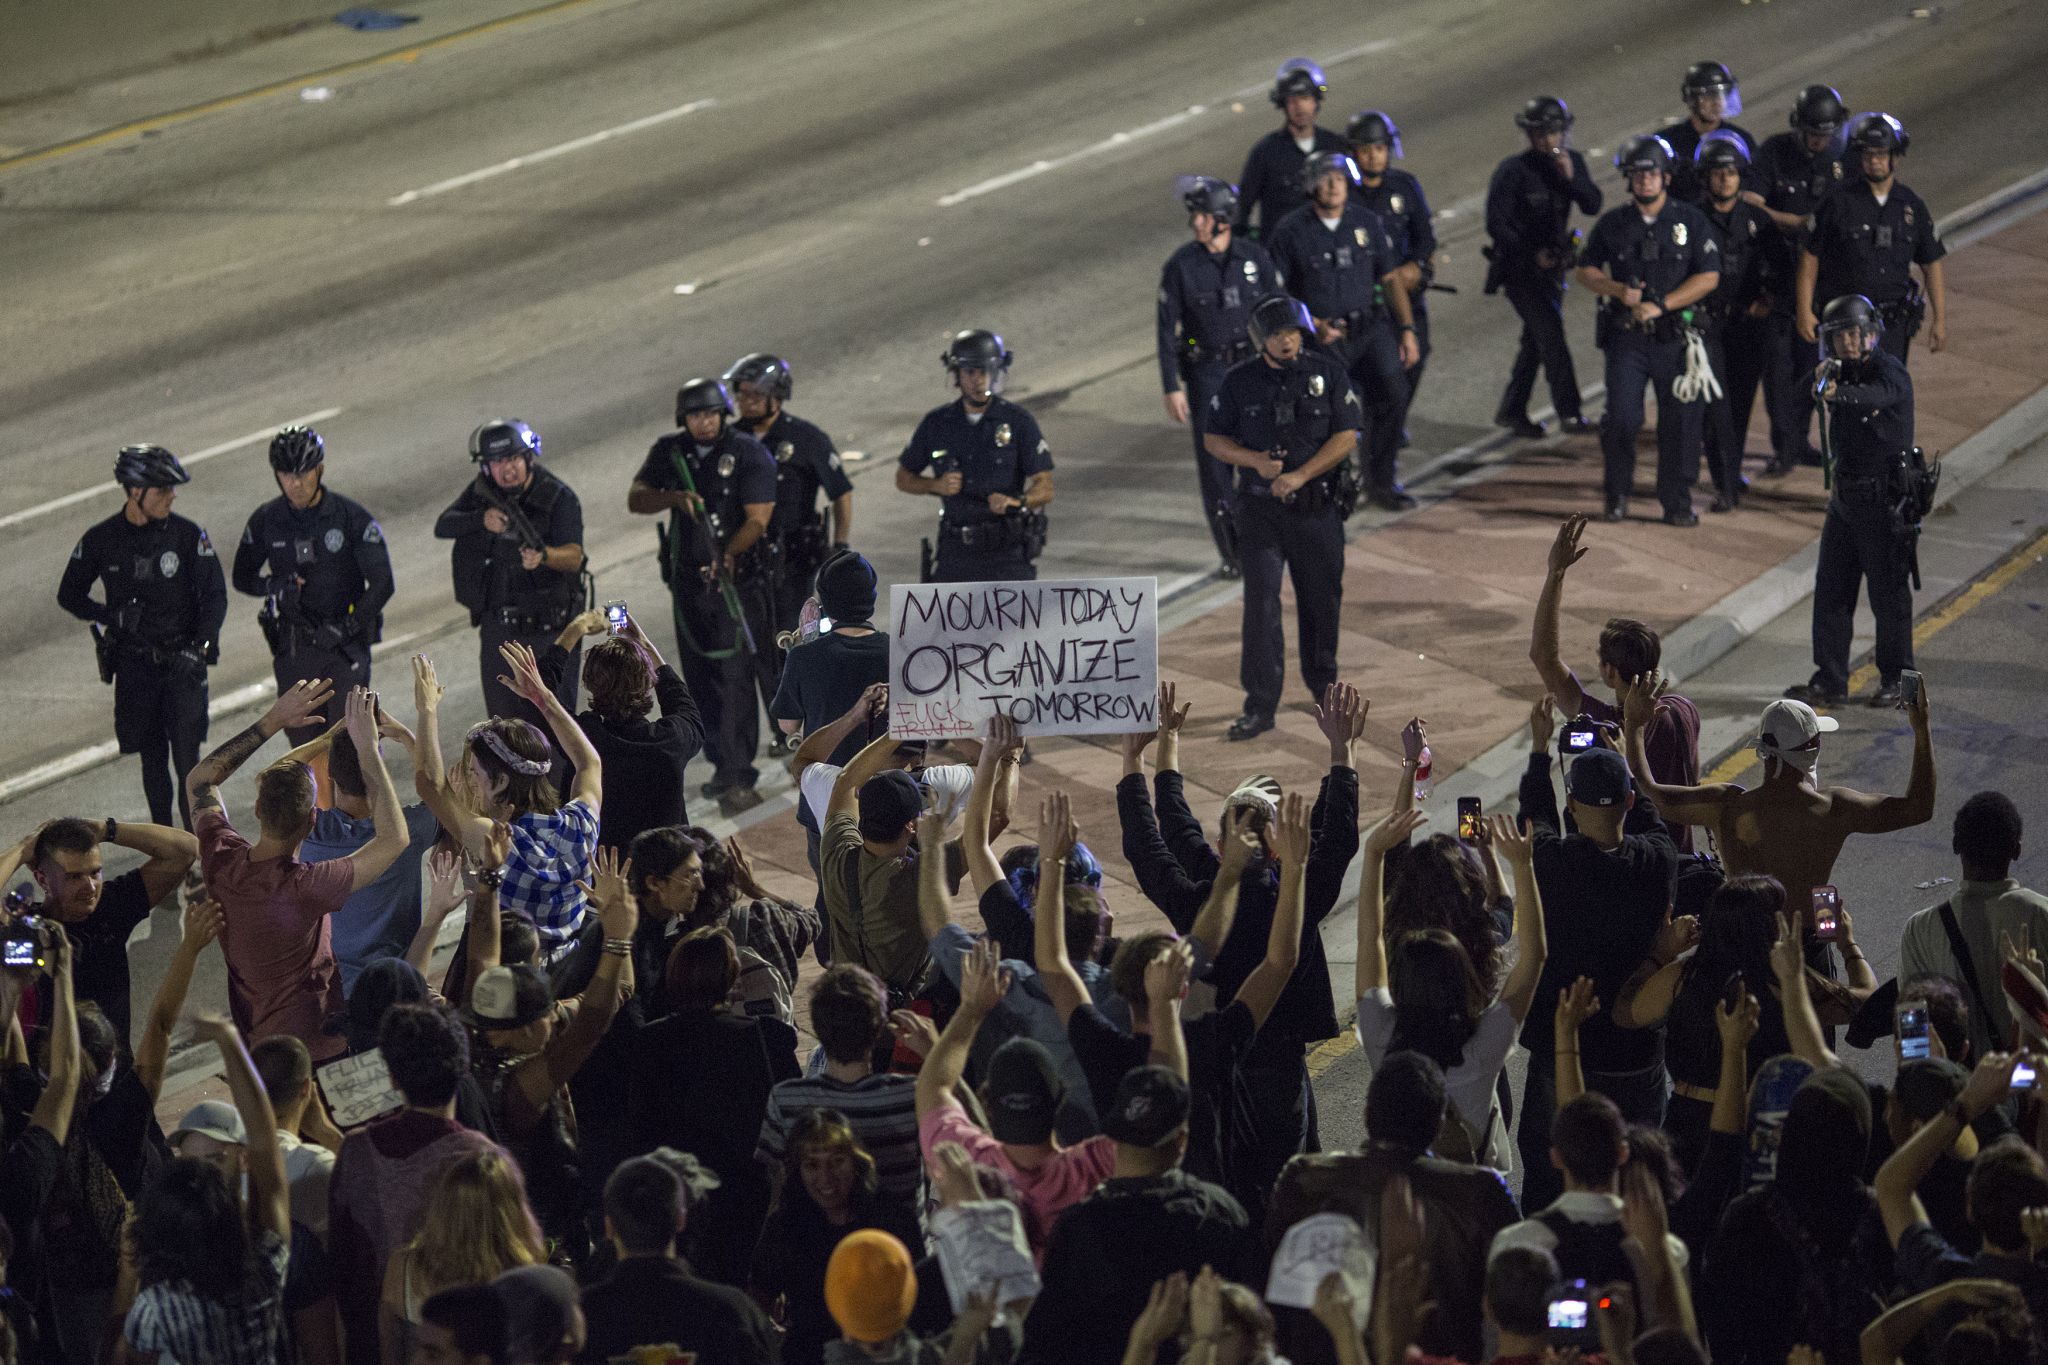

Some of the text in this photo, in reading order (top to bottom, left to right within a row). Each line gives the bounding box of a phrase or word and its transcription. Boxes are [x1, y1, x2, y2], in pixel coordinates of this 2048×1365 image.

[899, 586, 1144, 639] MOURN TODAY
[902, 637, 1141, 696] ORGANIZE
[896, 698, 961, 724] FUCK
[978, 690, 1156, 725] TOMORROW
